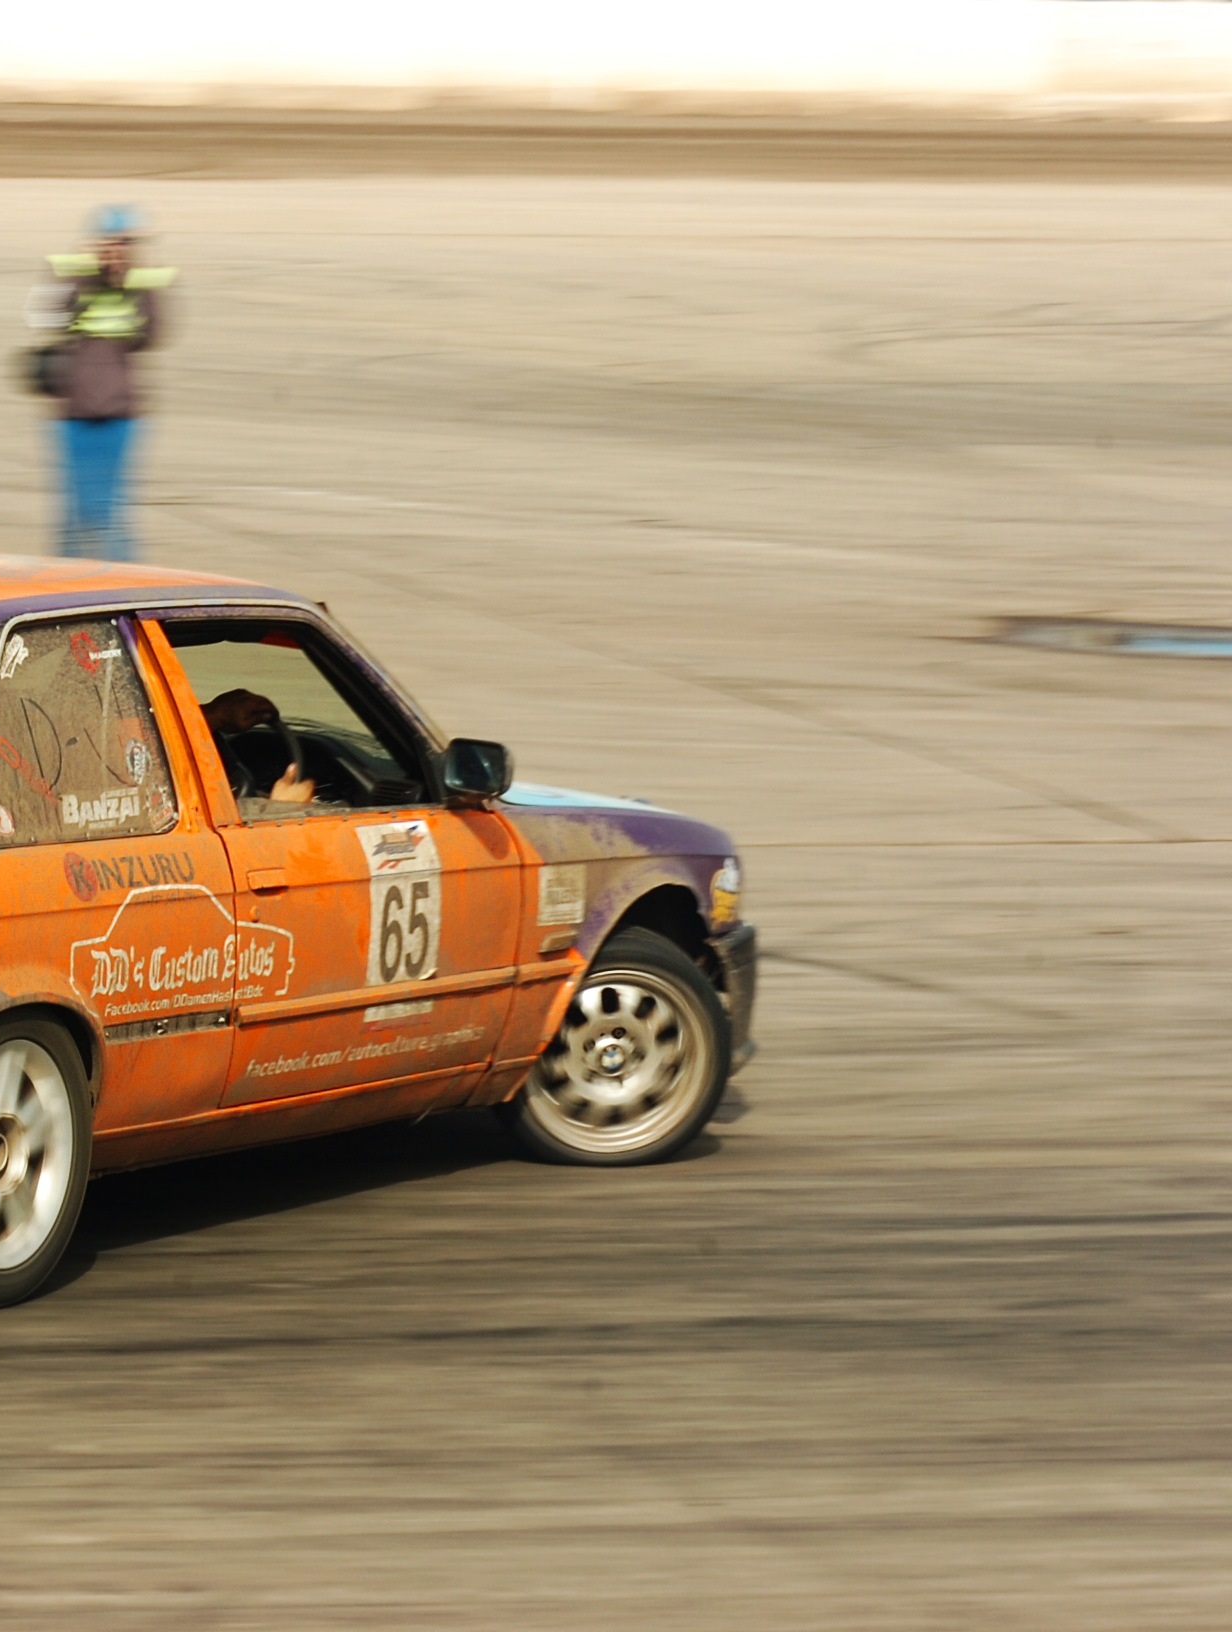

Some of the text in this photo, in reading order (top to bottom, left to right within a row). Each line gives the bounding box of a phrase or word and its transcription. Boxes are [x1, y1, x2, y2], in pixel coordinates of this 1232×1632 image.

[61, 791, 141, 828] BANZAI
[68, 851, 195, 893] KINZURU
[379, 881, 430, 983] 65
[148, 945, 218, 991] Custom
[221, 934, 275, 982] Autos
